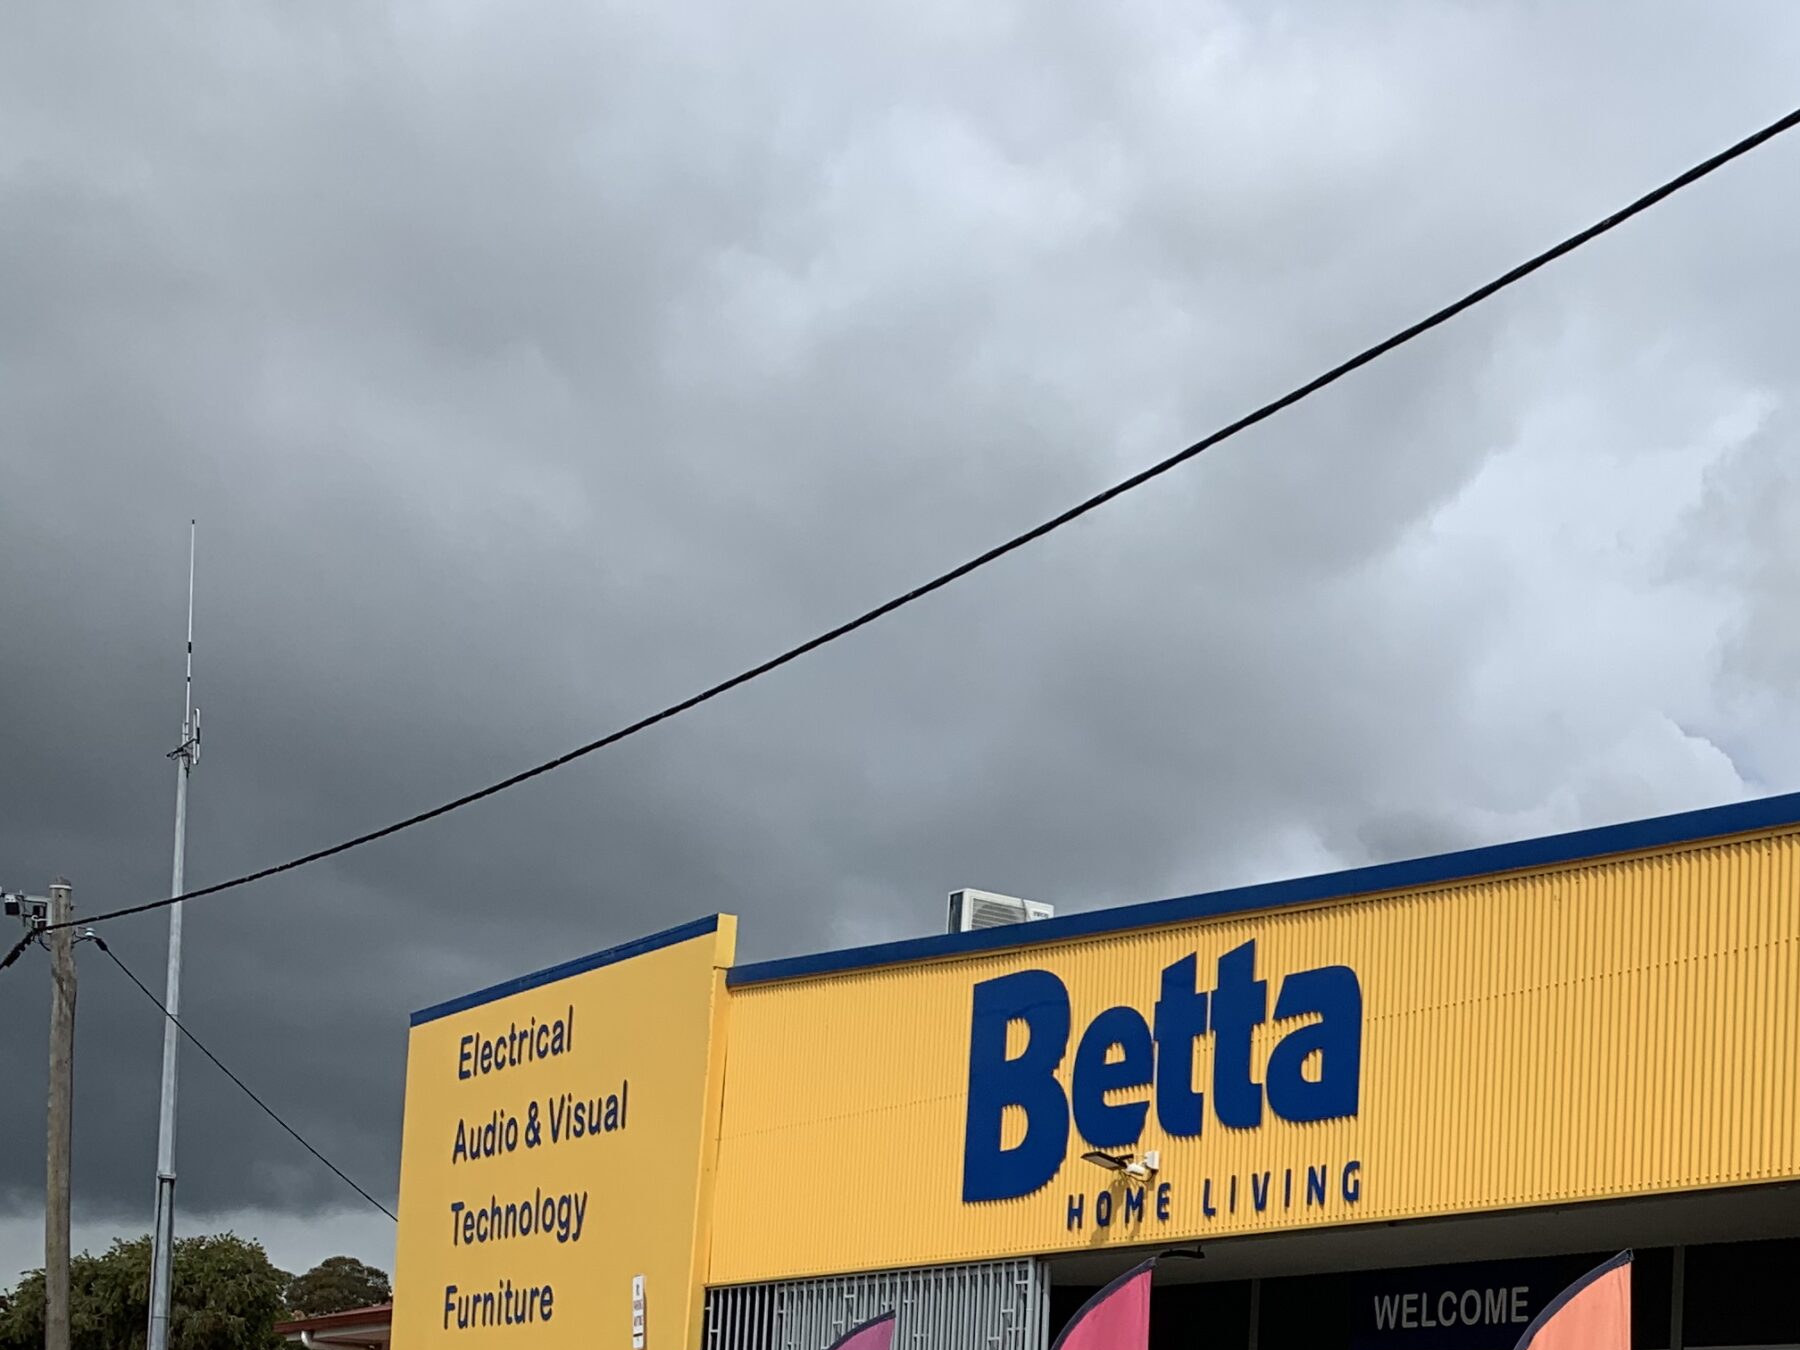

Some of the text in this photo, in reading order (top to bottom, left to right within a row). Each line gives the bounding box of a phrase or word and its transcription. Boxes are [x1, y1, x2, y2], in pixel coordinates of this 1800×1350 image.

[458, 1005, 574, 1081] Electrical
[963, 938, 1362, 1203] Betta
[453, 1080, 629, 1164] Audio & Visual
[451, 1188, 588, 1247] Technology
[1067, 1160, 1361, 1231] HOME LIVING
[443, 1279, 553, 1330] Furniture
[1374, 1286, 1530, 1331] WELCOME
